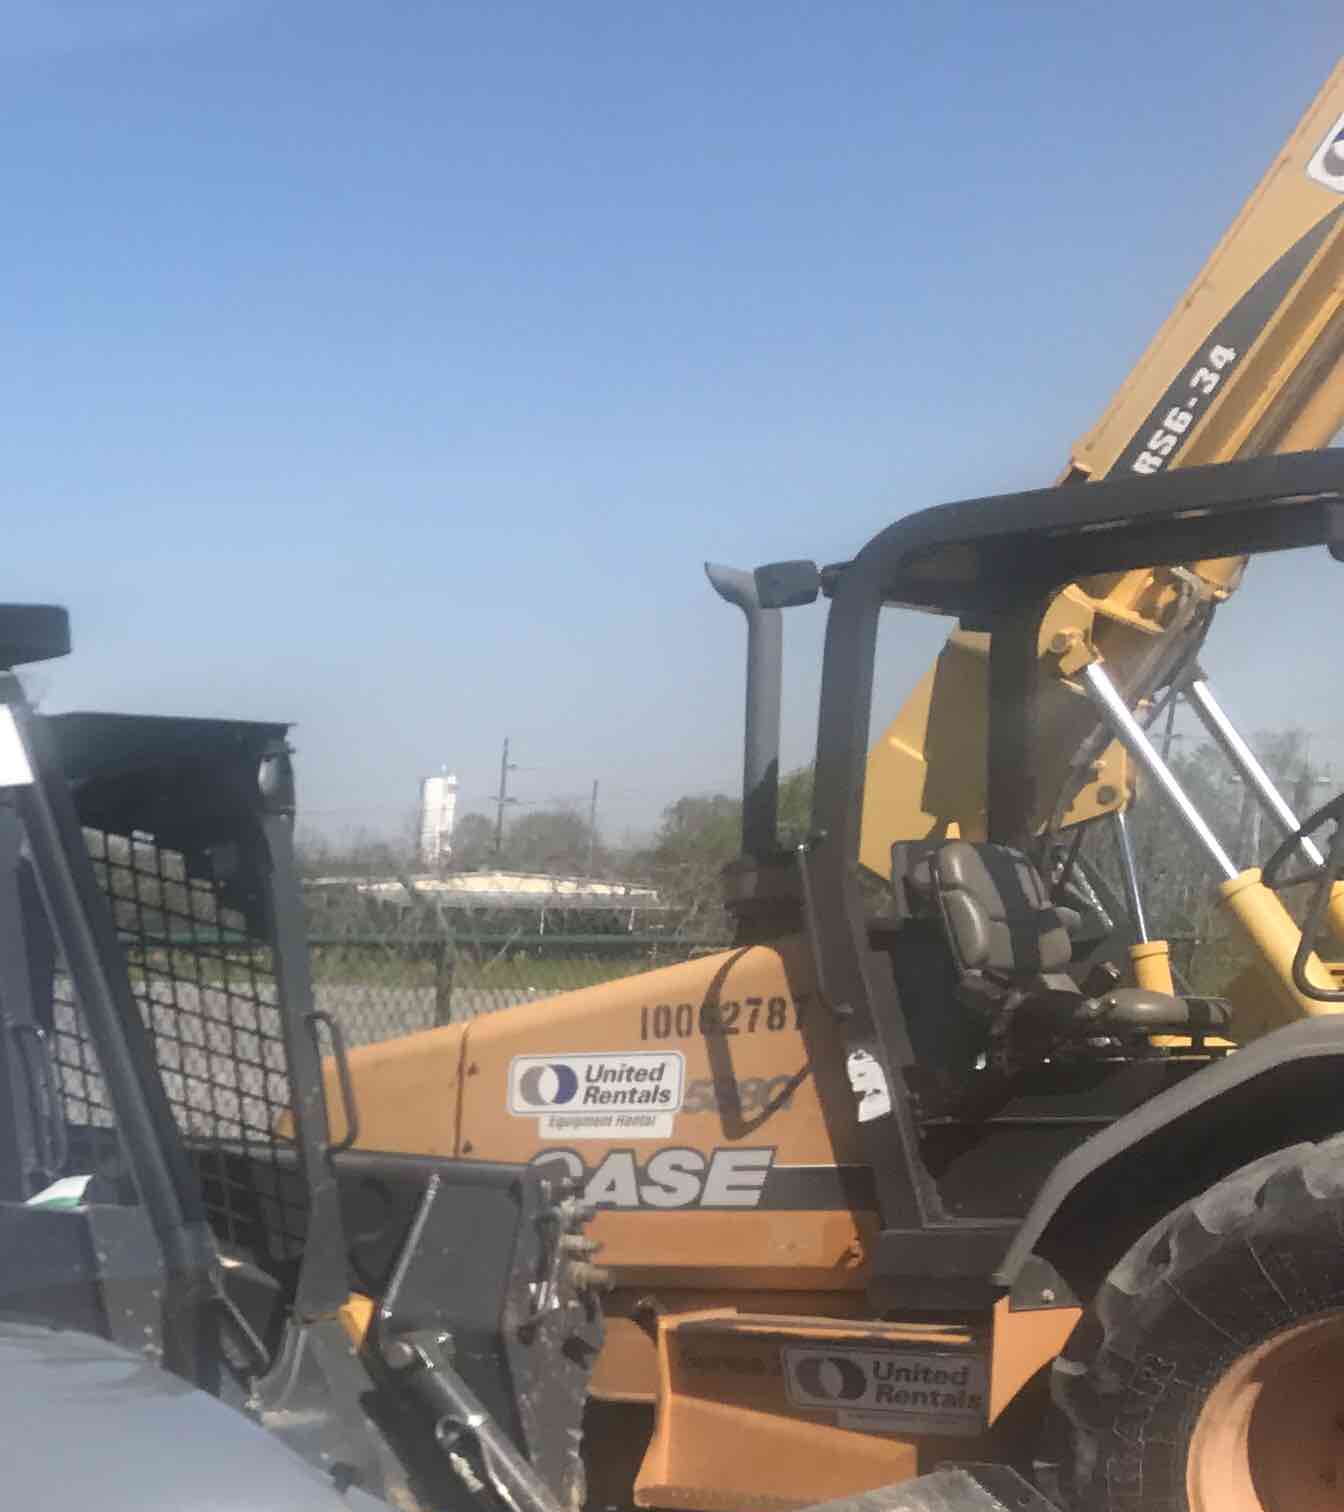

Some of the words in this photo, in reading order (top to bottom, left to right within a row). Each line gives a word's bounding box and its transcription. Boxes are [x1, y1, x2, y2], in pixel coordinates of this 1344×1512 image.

[1132, 344, 1237, 475] RS6-34
[584, 1062, 666, 1083] United
[581, 1083, 672, 1106] Rentals
[872, 1359, 970, 1386] United
[875, 1385, 983, 1410] Rentals
